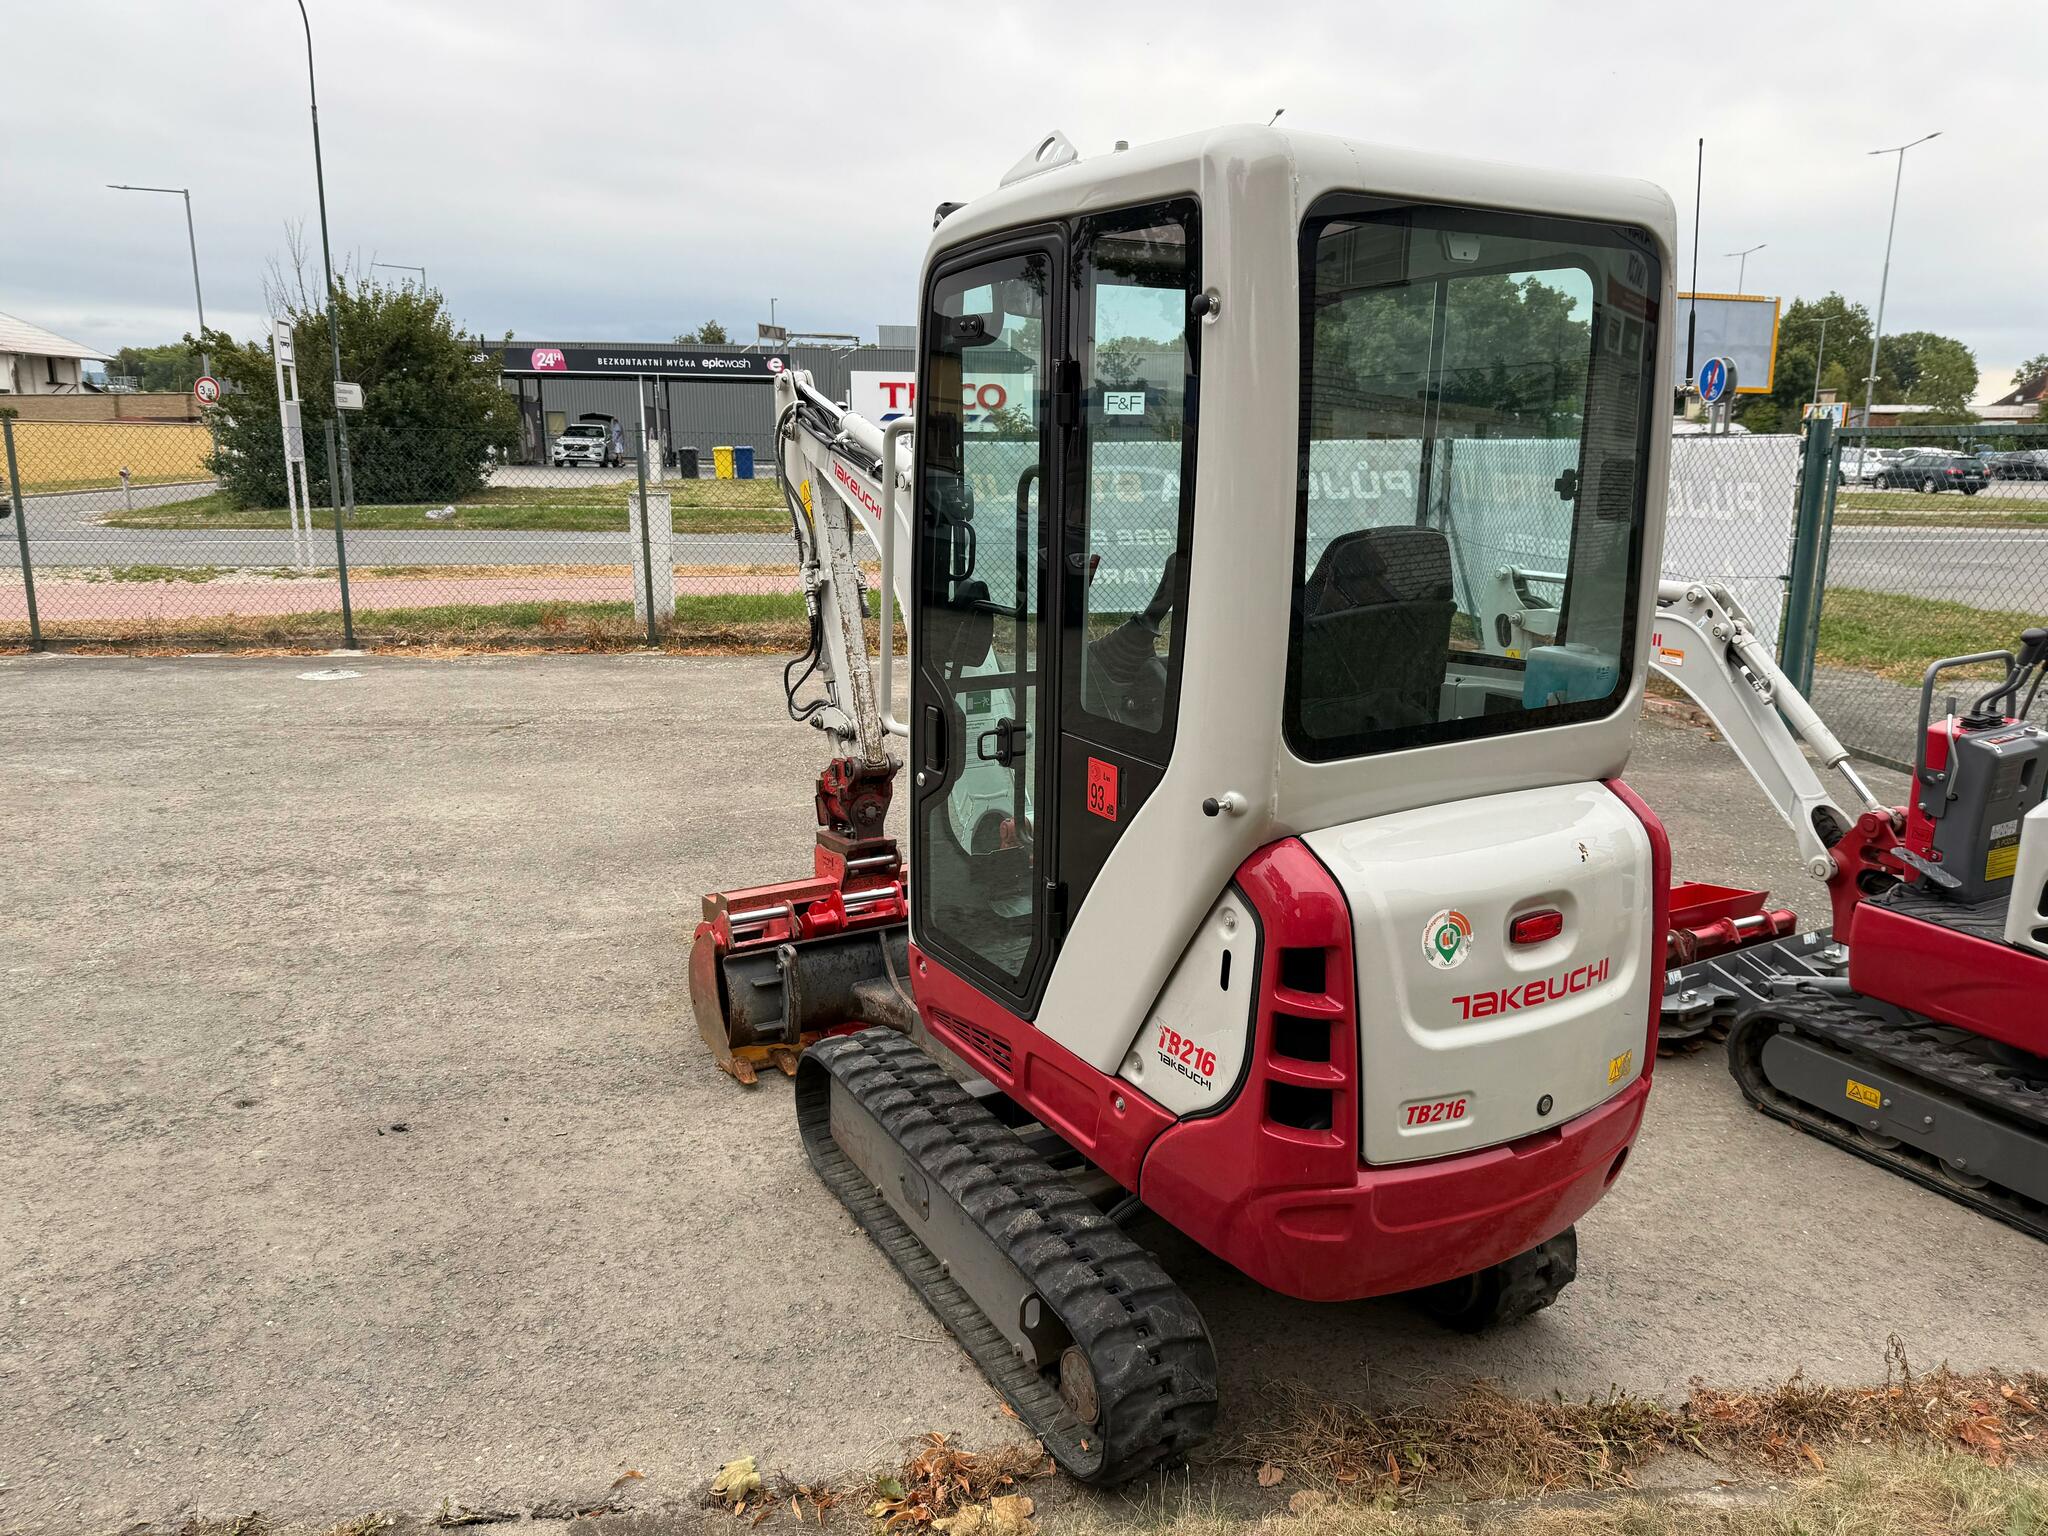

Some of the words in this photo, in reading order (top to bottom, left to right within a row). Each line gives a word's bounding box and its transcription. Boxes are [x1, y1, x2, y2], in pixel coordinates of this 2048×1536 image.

[536, 352, 561, 368] 24H
[597, 357, 663, 367] BEZKONTAKTNÍ
[666, 358, 696, 368] MYČKA
[701, 357, 751, 370] epicwash
[1106, 395, 1143, 412] F&F
[1090, 782, 1105, 811] 93
[1452, 957, 1609, 1020] TAKEUCHI
[1158, 1025, 1217, 1077] TB216
[1406, 1098, 1467, 1126] TB216
